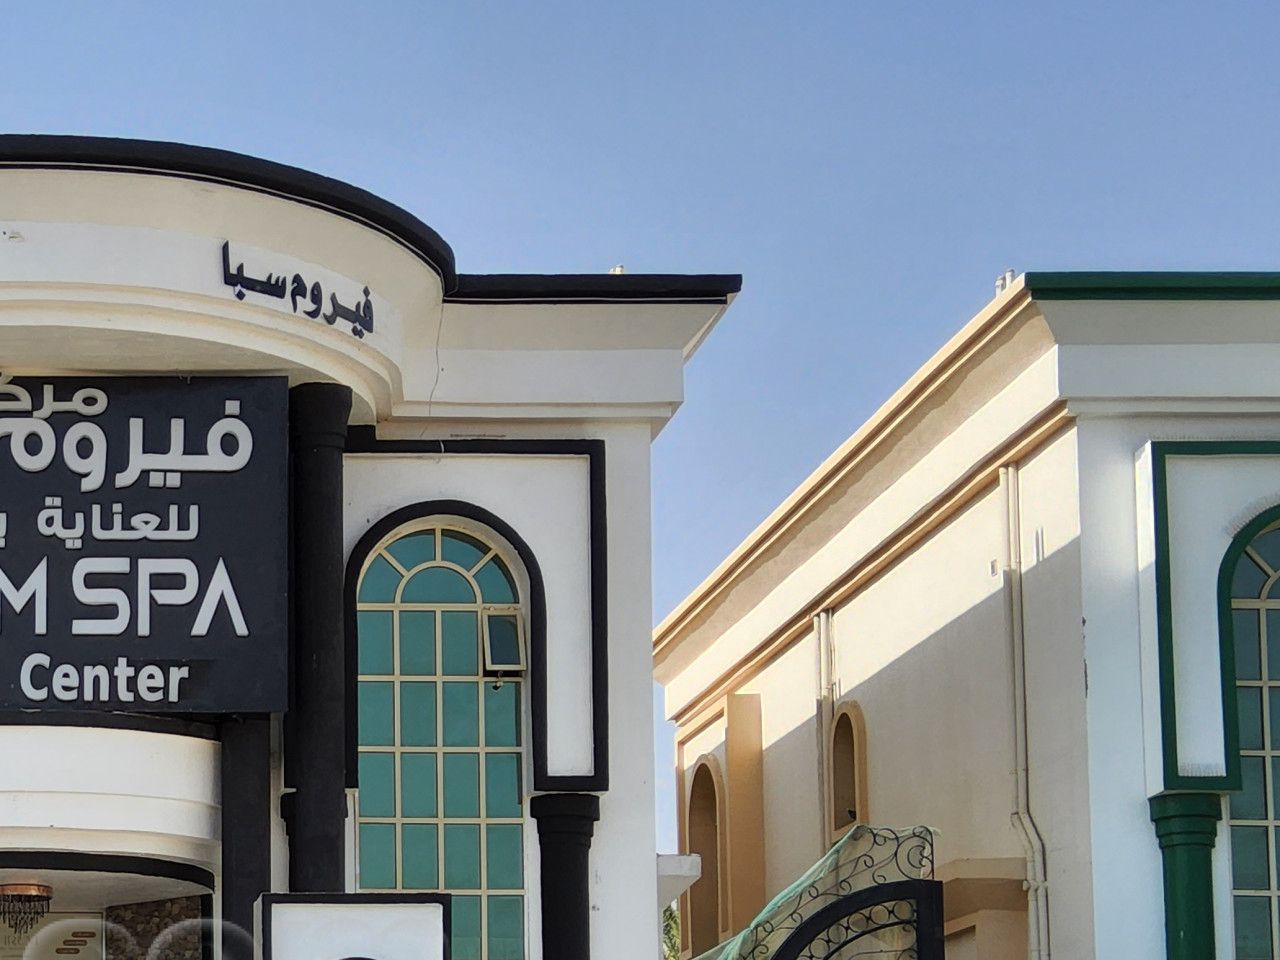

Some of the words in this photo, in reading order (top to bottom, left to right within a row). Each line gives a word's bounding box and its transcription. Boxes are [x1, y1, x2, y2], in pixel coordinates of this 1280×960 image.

[222, 240, 287, 301] سبا
[291, 273, 374, 339] فيروم
[37, 497, 199, 549] للعناية
[71, 556, 250, 638] SPA
[20, 652, 190, 703] Center
